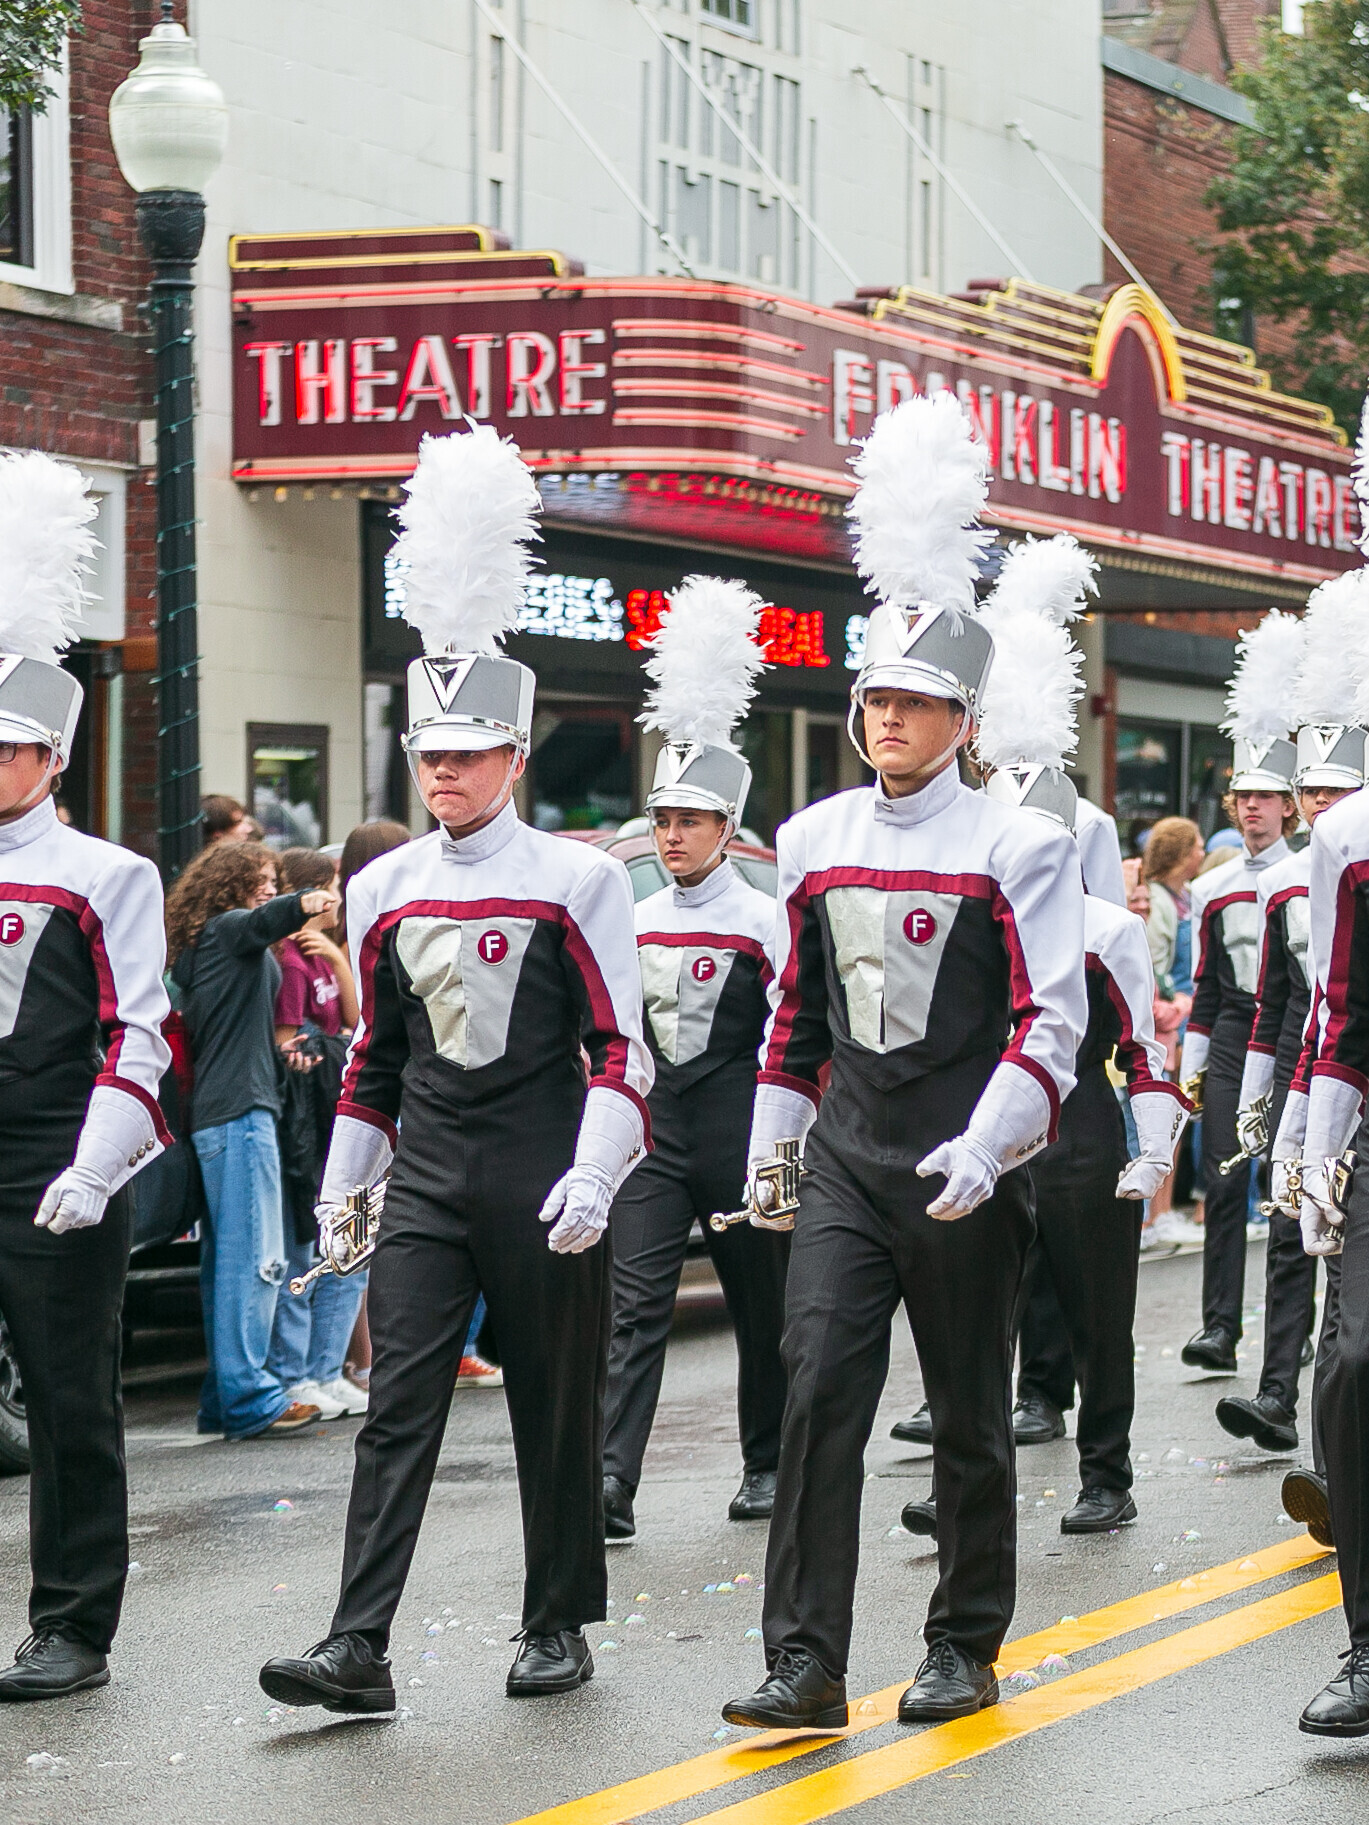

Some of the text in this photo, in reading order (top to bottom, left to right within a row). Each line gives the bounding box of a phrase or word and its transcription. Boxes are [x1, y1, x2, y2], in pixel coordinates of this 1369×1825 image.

[243, 329, 607, 426] THEATRE
[834, 349, 1359, 553] FNKLIN THEATRE
[2, 917, 19, 940] F
[912, 915, 928, 938] F
[485, 934, 501, 959] F
[698, 961, 711, 978] F
